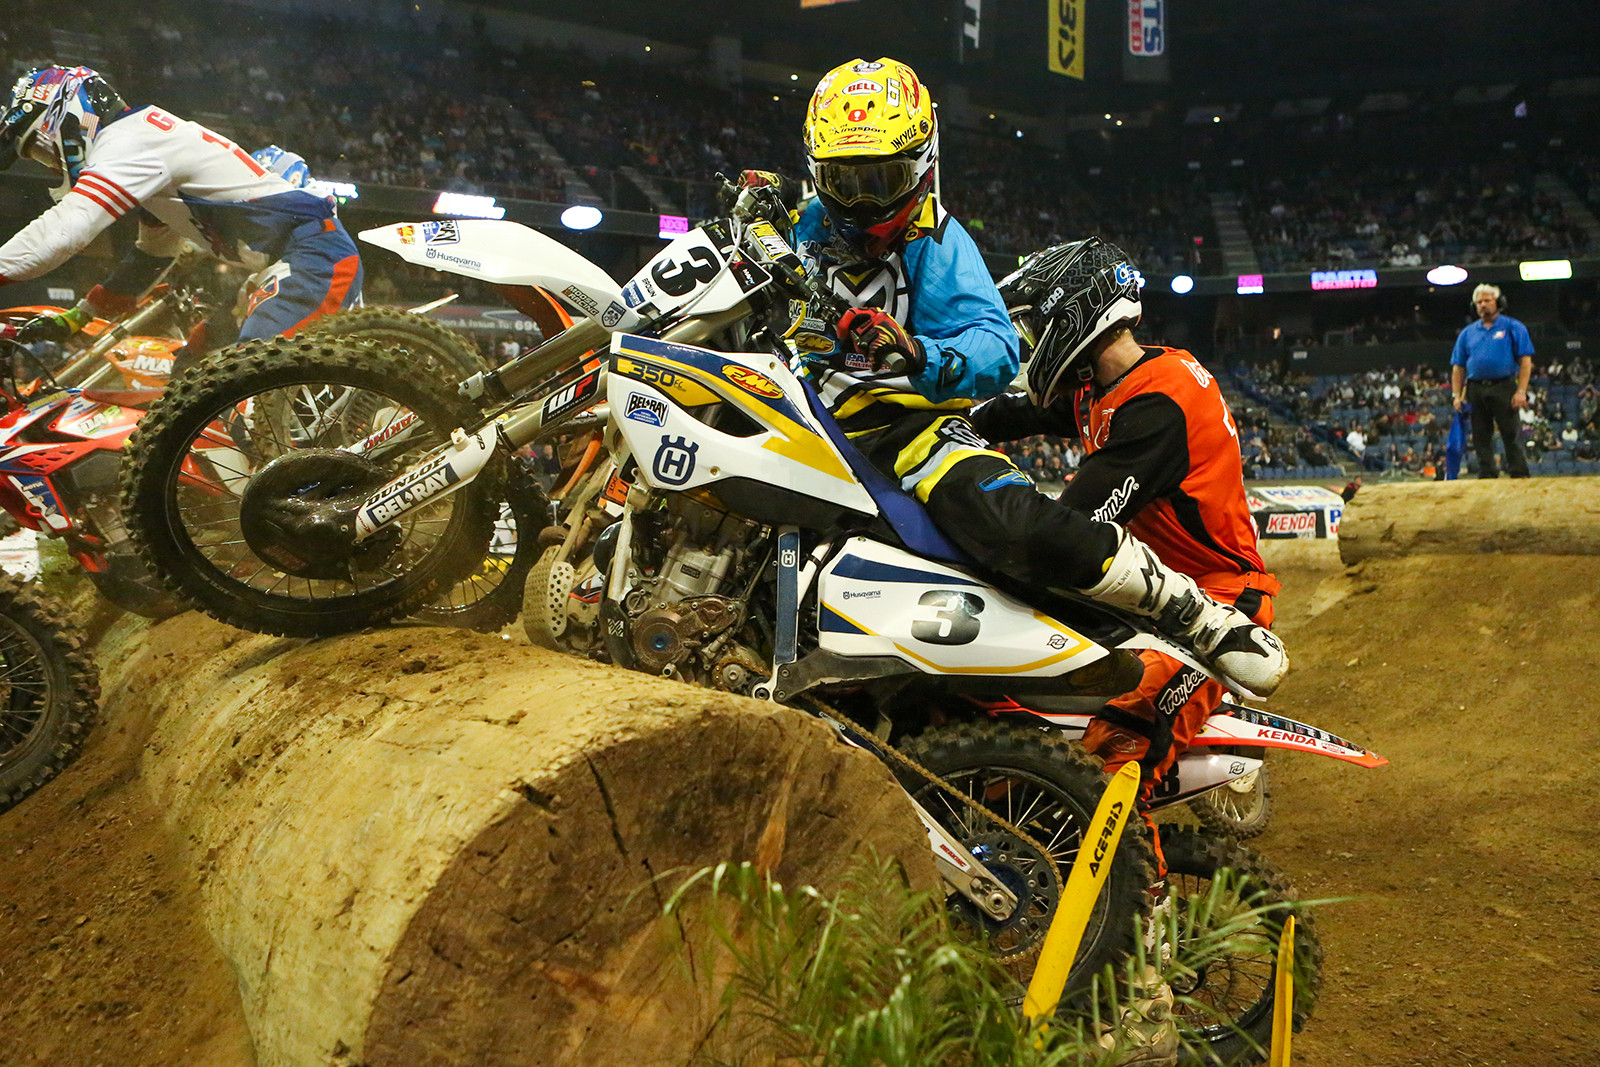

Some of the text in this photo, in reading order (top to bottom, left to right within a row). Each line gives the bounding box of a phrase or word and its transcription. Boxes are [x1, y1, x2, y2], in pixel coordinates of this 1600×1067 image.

[848, 83, 878, 93] BELL
[437, 252, 481, 268] Husqvarna
[652, 245, 721, 297] 3
[567, 285, 598, 307] MOOSE
[568, 292, 600, 317] RACING
[1039, 286, 1065, 315] 509
[628, 361, 675, 387] 350
[721, 365, 782, 396] FMF
[365, 455, 447, 508] DUNLOP
[1266, 512, 1317, 534] KENDA
[850, 590, 881, 599] Husqvarna
[911, 590, 986, 646] 3
[1257, 728, 1318, 747] KENDA
[1088, 800, 1124, 879] ACERBIS
